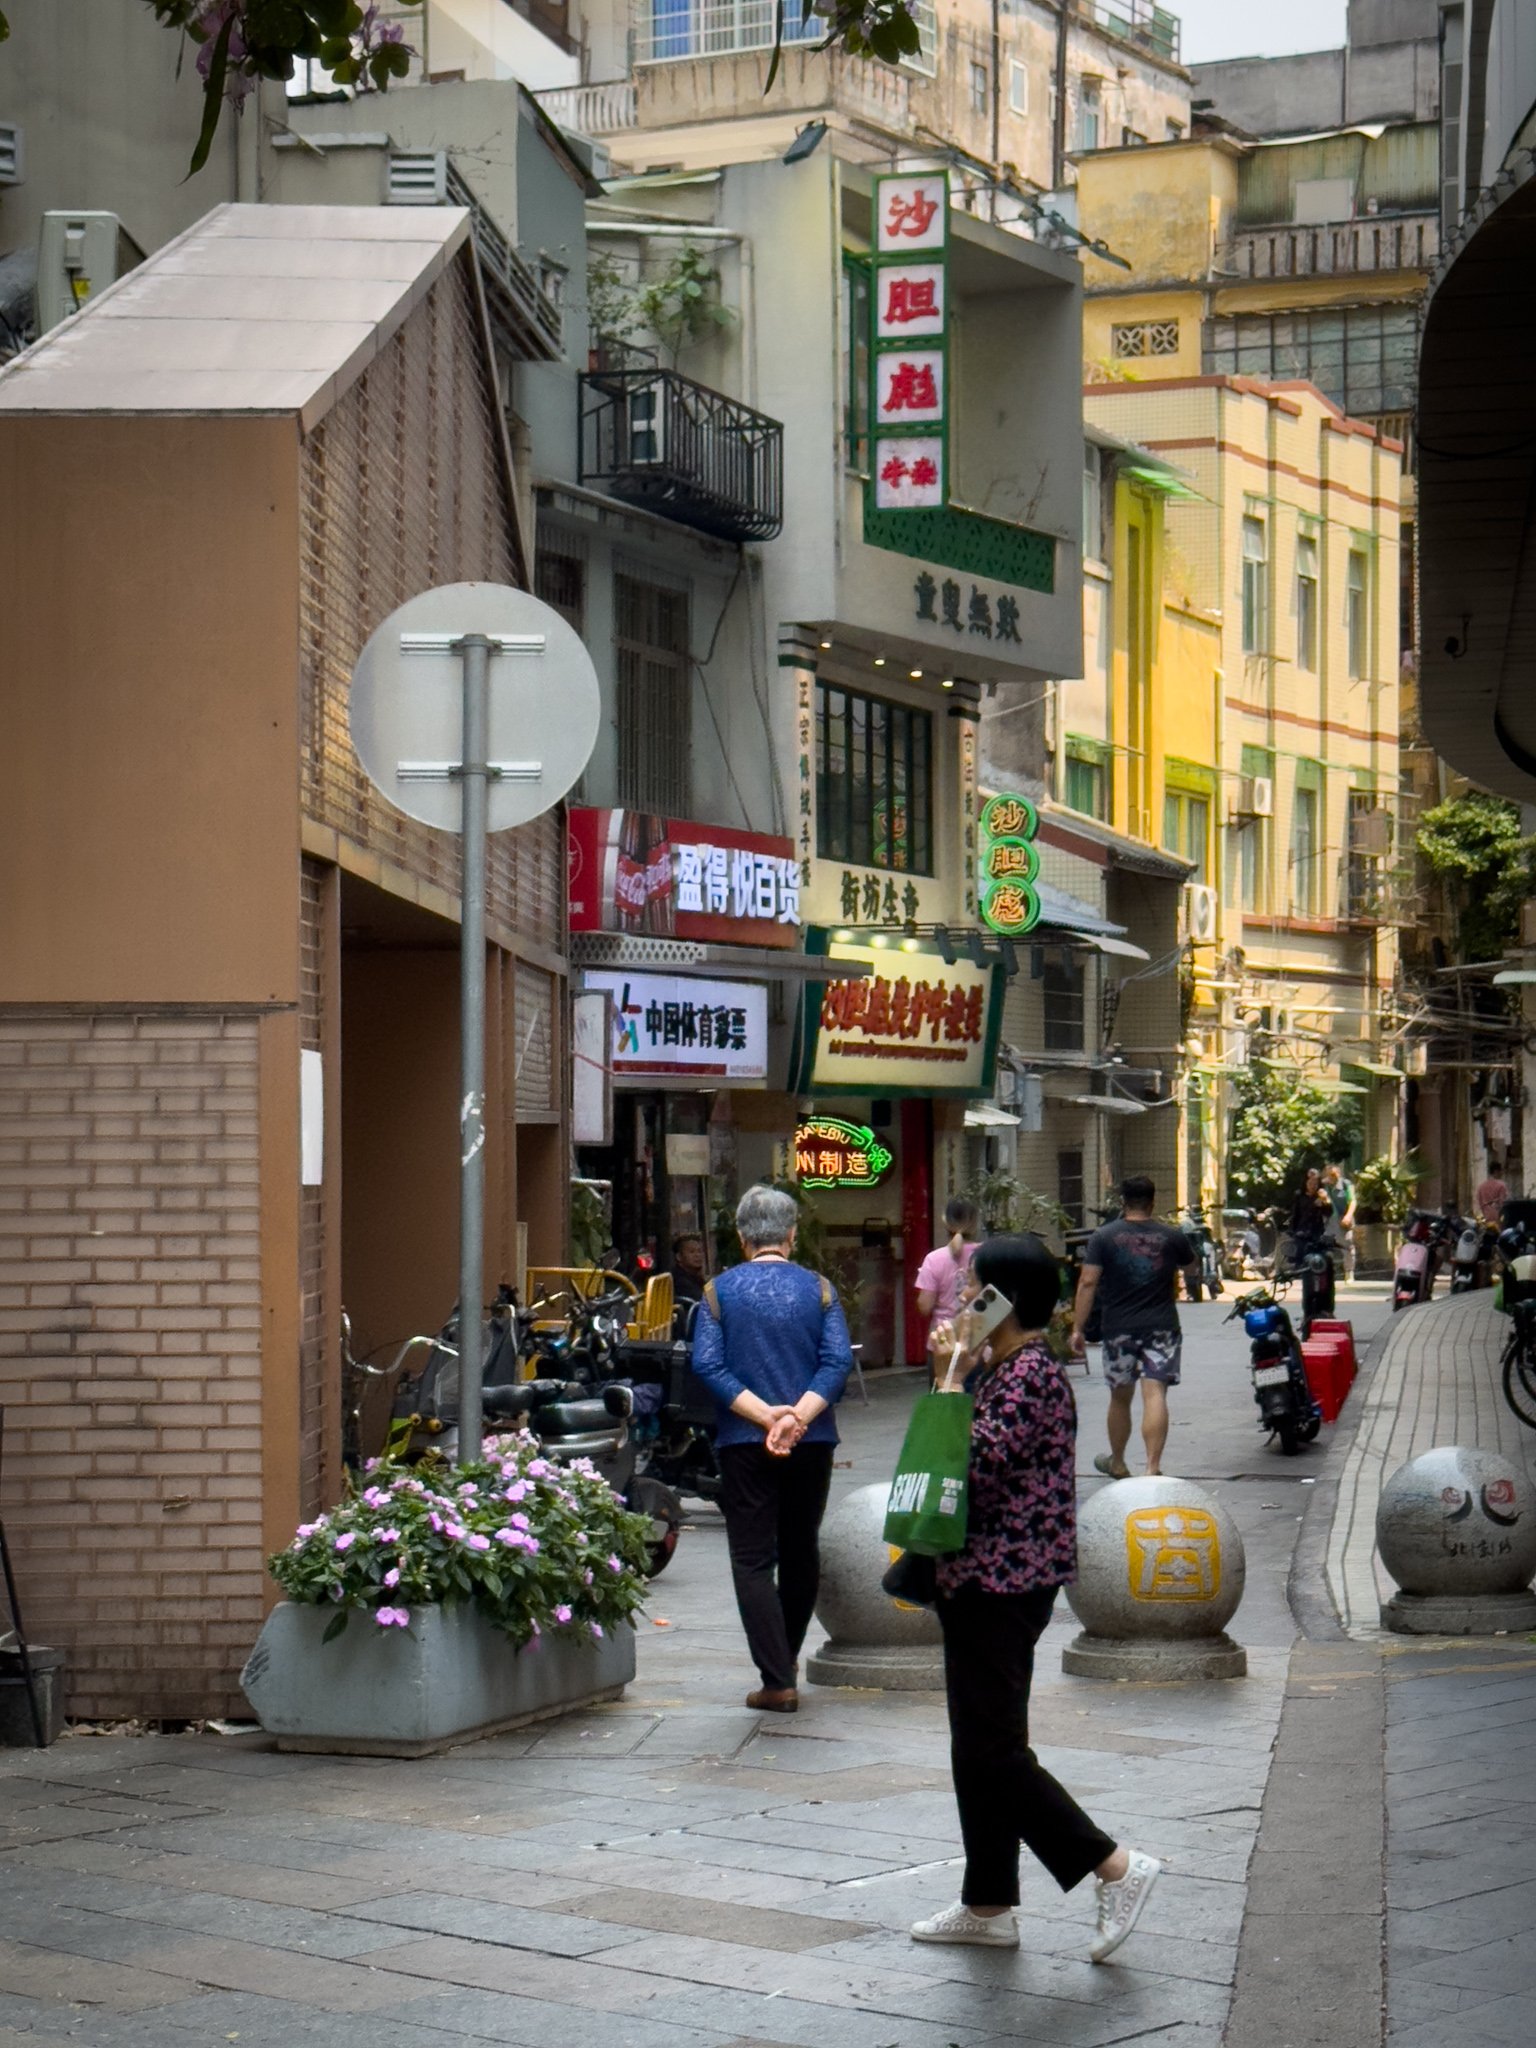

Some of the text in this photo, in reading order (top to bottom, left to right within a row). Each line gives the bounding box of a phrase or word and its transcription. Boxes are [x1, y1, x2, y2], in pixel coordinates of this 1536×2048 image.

[883, 188, 939, 411] 沙胆彪
[881, 455, 938, 489] 牛杂
[678, 844, 801, 925] 盈得悦百货
[989, 800, 1028, 922] 沙胆彪
[645, 999, 748, 1050] 中国体育彩票
